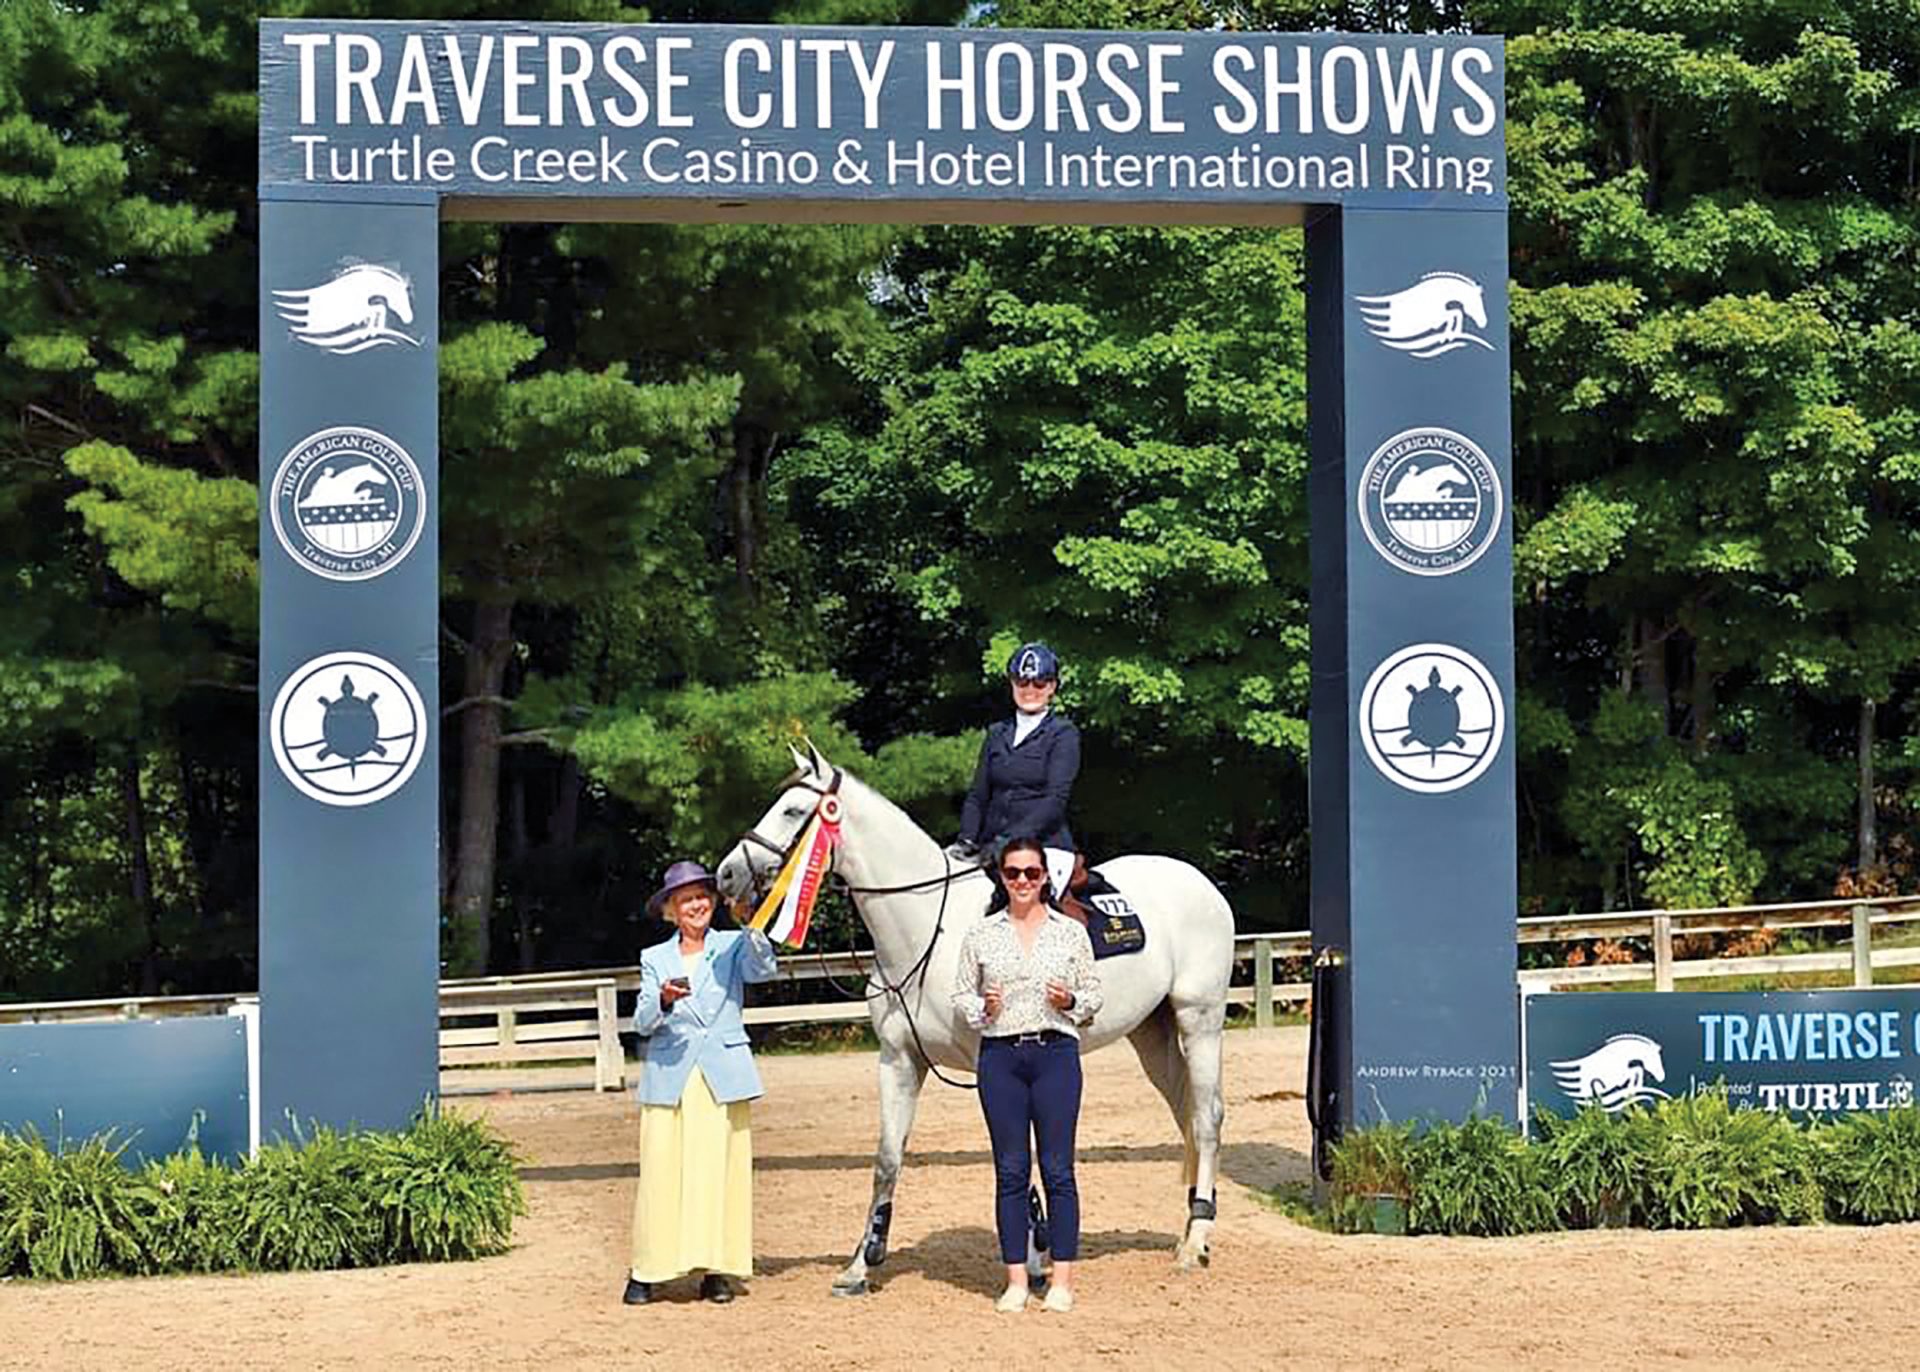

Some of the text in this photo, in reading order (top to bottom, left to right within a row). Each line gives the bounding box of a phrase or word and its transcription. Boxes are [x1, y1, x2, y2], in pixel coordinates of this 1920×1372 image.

[283, 33, 1496, 136] TRAVERSE CITY HORSE SHOWS
[290, 135, 1493, 195] Turtle Creek Casino & Hotel International Ring
[282, 437, 414, 496] THE AMERICAN GOLD CUP
[1369, 437, 1492, 492] THE AMERICAN GOLD CUP
[378, 541, 397, 559] MI
[1456, 540, 1474, 557] MI
[1699, 1012, 1900, 1062] TRAVERSE
[1697, 1082, 1752, 1095] Preented
[1758, 1081, 1913, 1112] TURTLE
